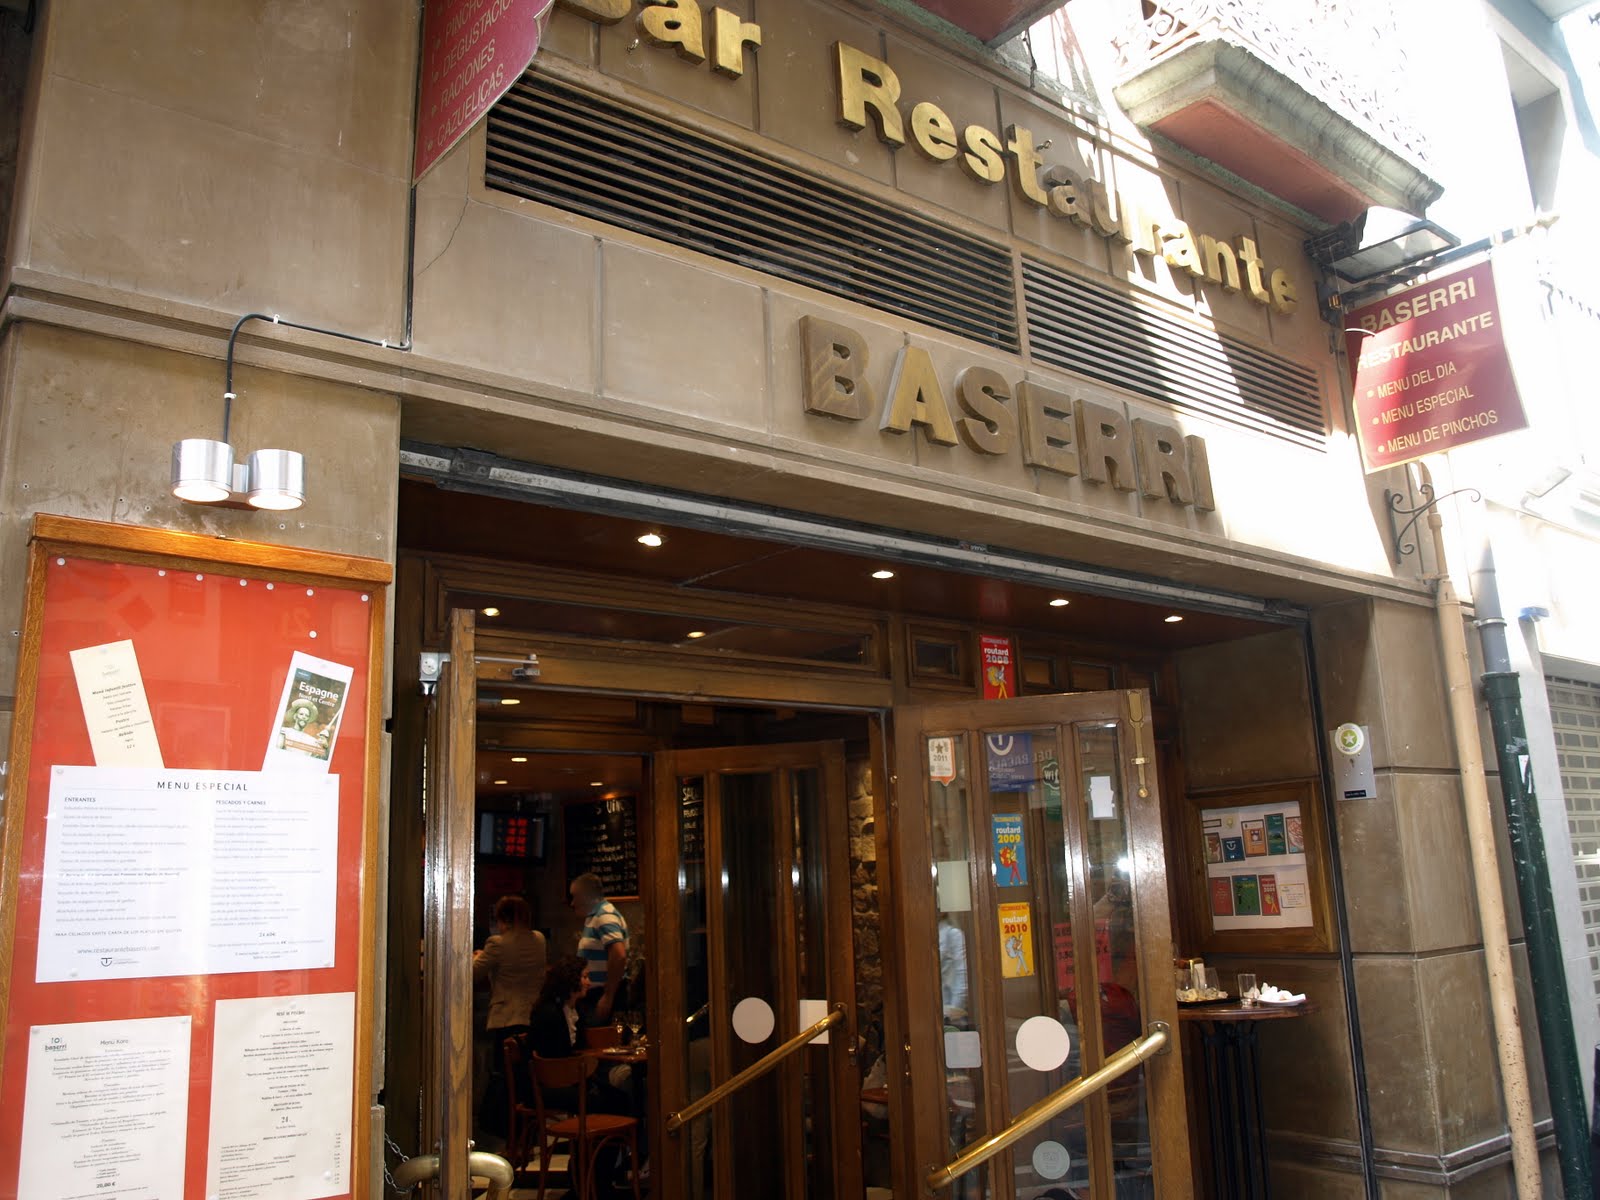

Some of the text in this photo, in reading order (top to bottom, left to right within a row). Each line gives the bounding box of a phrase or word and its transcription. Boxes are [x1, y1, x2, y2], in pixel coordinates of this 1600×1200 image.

[443, 0, 513, 76] DEGUSTACIO
[445, 0, 484, 44] PINCHO
[441, 39, 495, 112] RACIONES
[437, 63, 504, 147] CAZUELICAS
[553, 0, 1297, 316] ar Restaurante
[1360, 276, 1476, 336] BASERRI
[1357, 311, 1494, 371] RESTAURANTE
[1377, 361, 1457, 399] MENU DEL DIA
[800, 314, 1216, 512] BASERRI
[1381, 386, 1474, 425] MENU ESPECIAL
[1387, 409, 1498, 453] MENU DE PINCHOS
[984, 647, 1009, 656] routard
[298, 681, 339, 700] Espagne
[319, 698, 335, 707] Centre
[933, 754, 948, 762] 2011
[157, 781, 248, 792] MENU ESPECIAL
[995, 826, 1021, 834] routard
[997, 834, 1021, 844] 2009
[1002, 914, 1028, 923] routard
[1004, 923, 1028, 934] 2010
